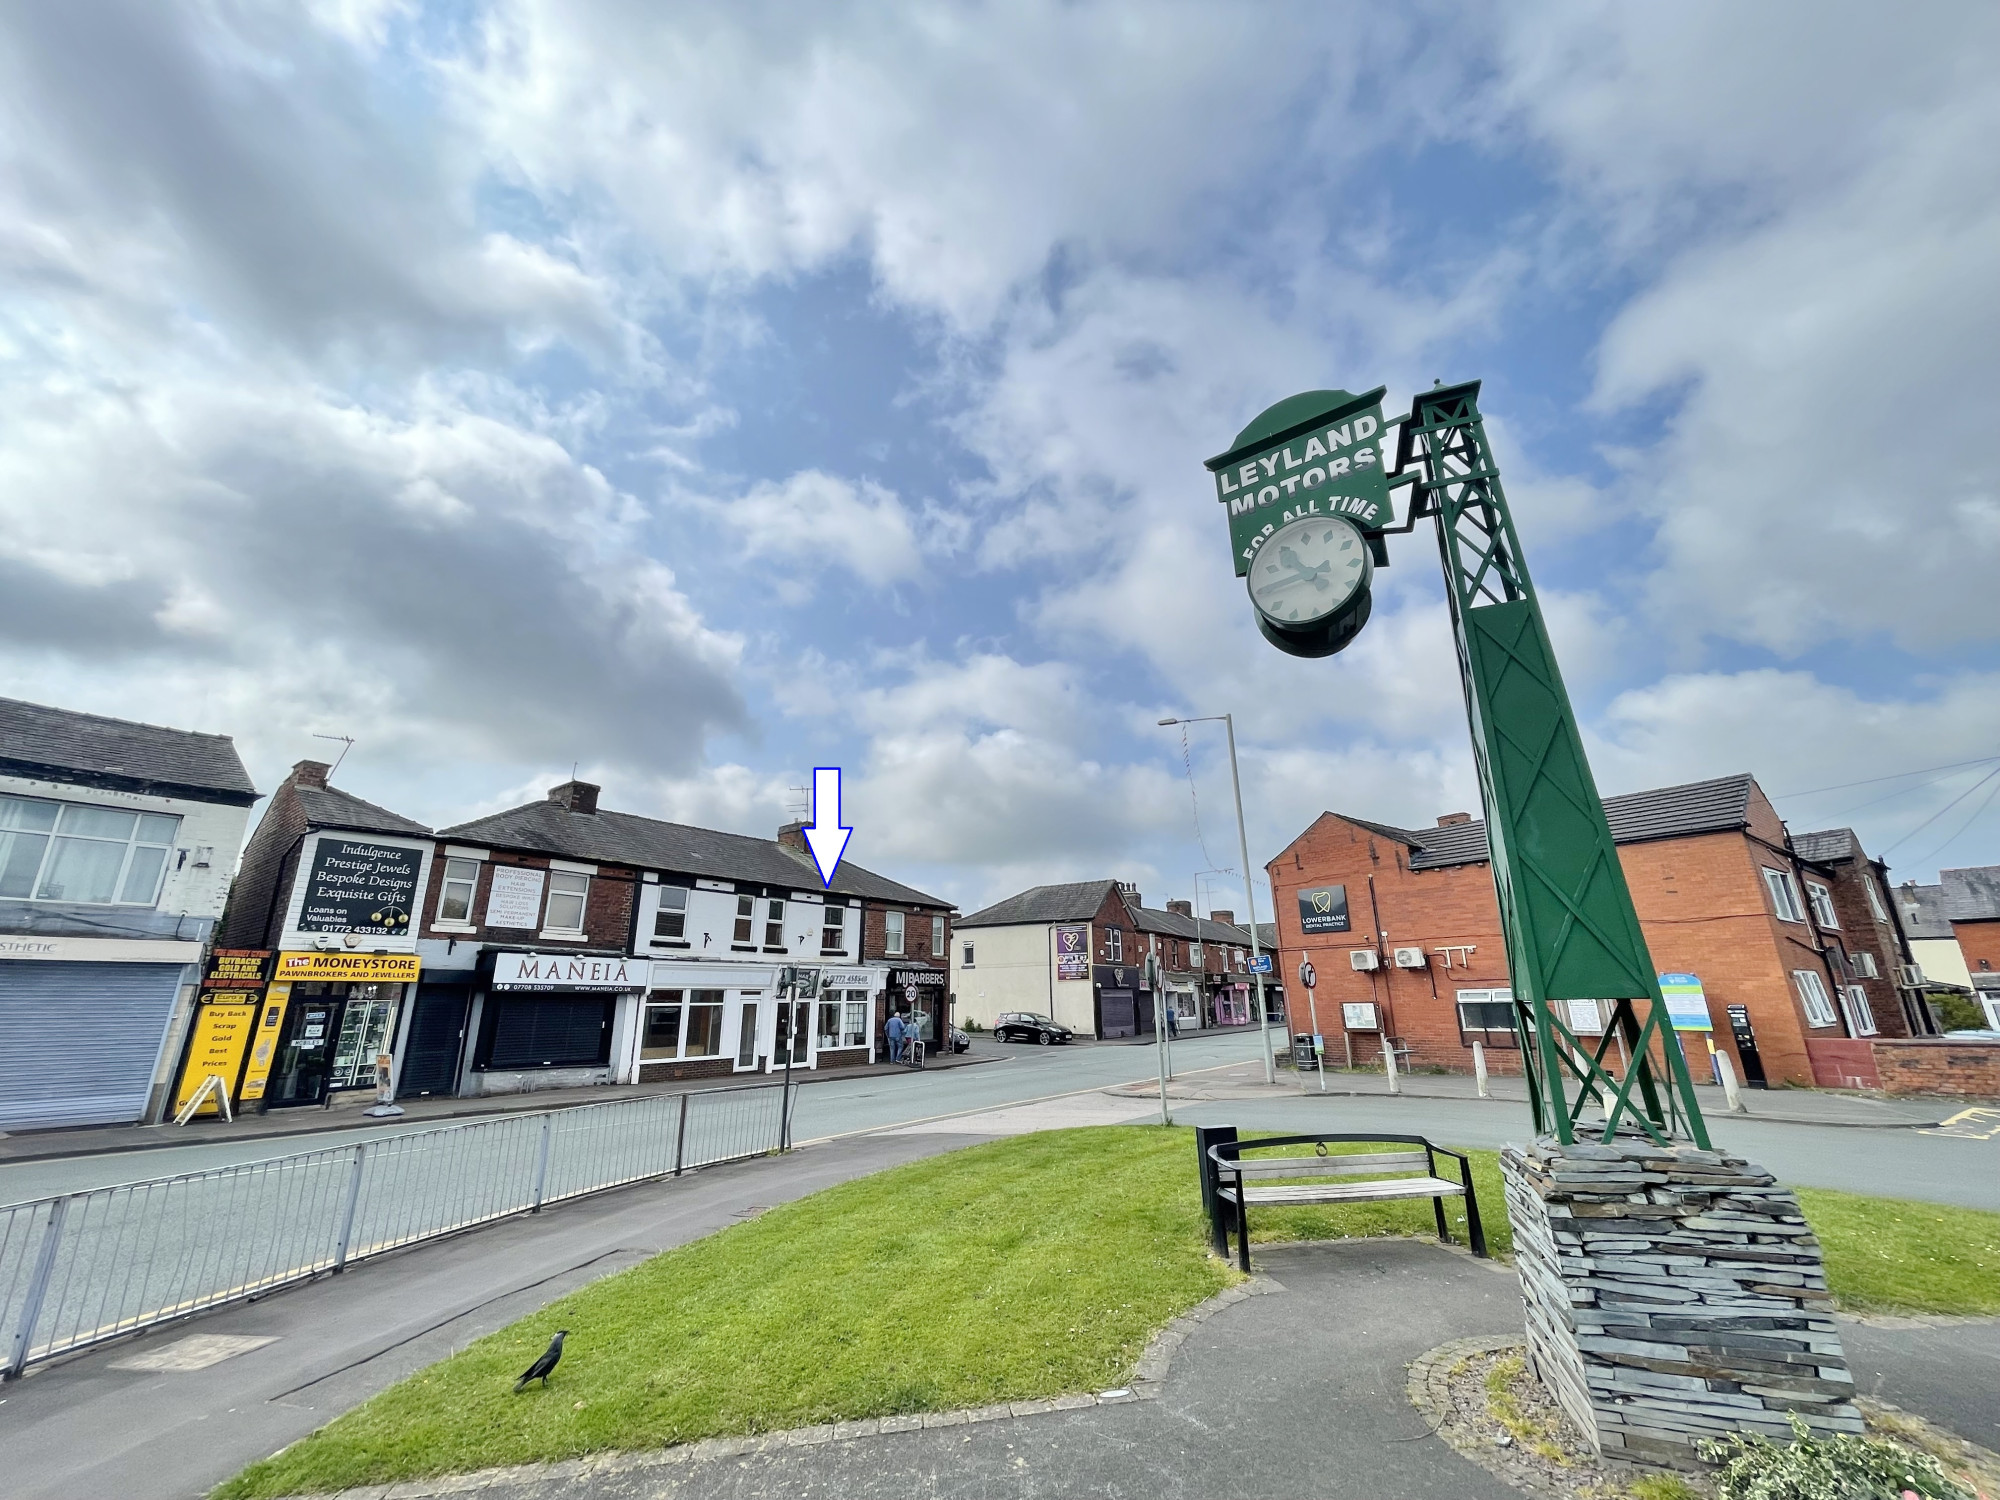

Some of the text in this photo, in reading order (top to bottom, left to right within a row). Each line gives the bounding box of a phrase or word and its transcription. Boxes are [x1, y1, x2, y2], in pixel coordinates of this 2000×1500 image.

[1220, 415, 1378, 495] LEYLAND
[1230, 447, 1376, 519] MOTORS
[1242, 496, 1379, 559] FOR ALL TIME
[341, 844, 401, 860] Indulgence
[324, 857, 411, 875] Prestige Jewels
[496, 868, 542, 877] PROFESSIONAL
[316, 871, 412, 891] Bespoke Designs
[317, 886, 406, 905] Exquisite Gifts
[308, 906, 335, 914] Loans
[306, 914, 347, 923] Valuables
[1302, 914, 1346, 924] LOWERBANK
[322, 924, 388, 935] 01772 433132
[218, 957, 262, 965] BUYBACKS
[287, 957, 416, 969] The MONEYSTORE
[218, 964, 240, 972] GOLD
[516, 960, 629, 981] MANEIA
[209, 971, 262, 979] ELECTRICALS
[279, 970, 348, 978] PAWNBROKERS
[906, 990, 915, 998] 20
